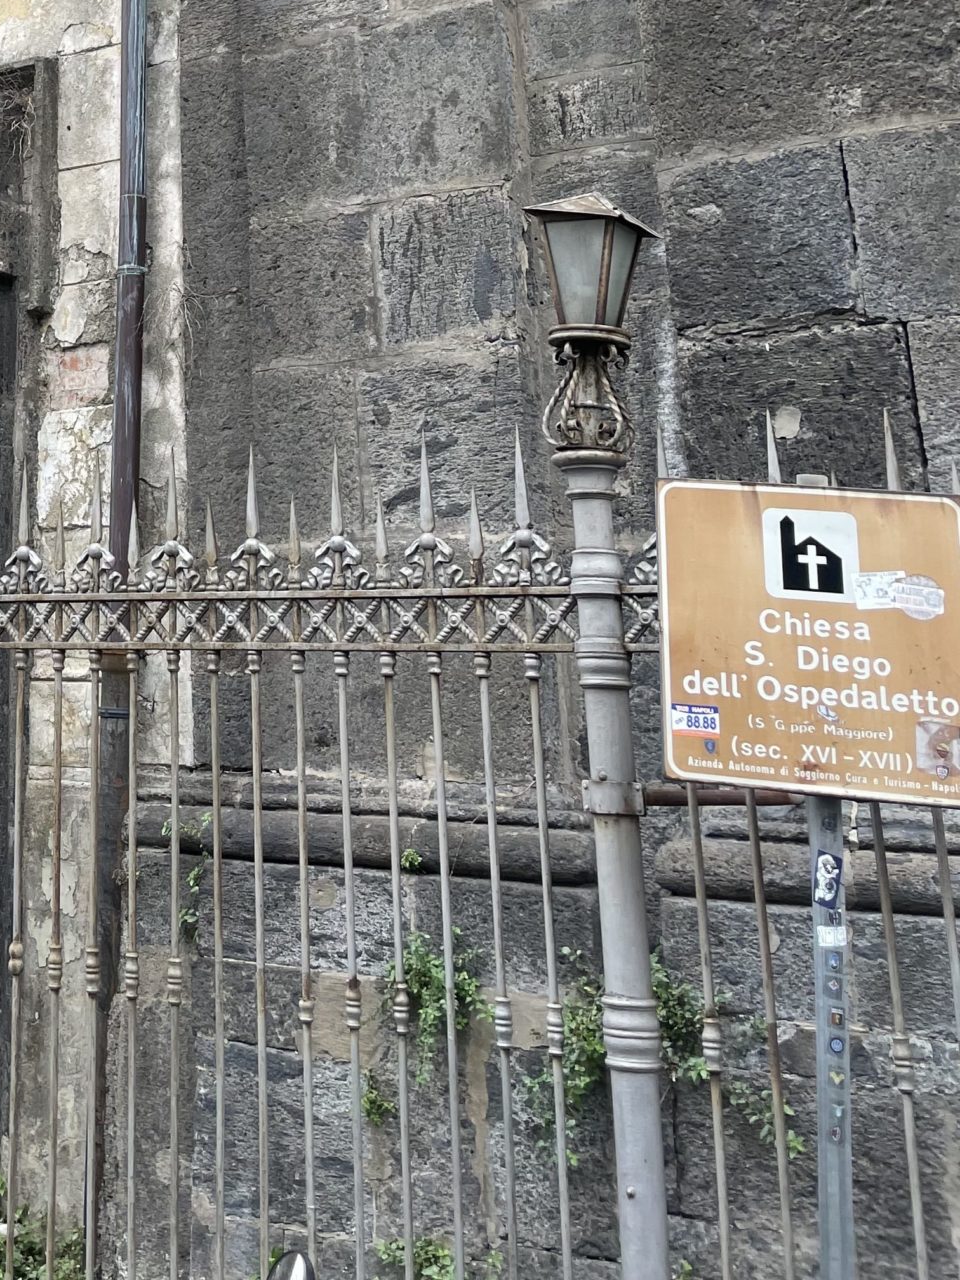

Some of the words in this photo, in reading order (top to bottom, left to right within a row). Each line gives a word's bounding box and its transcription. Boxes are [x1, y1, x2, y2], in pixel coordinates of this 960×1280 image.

[759, 608, 871, 642] Chiesa
[744, 640, 774, 667] S.
[797, 645, 891, 680] Diego
[683, 670, 748, 698] dell'
[756, 675, 960, 717] Ospedaletto
[823, 724, 893, 741] Maggiore)
[731, 735, 788, 760] (sec.
[801, 744, 837, 765] XVI
[688, 756, 723, 769] Azienda
[728, 760, 775, 775] Autonoma
[780, 765, 789, 776] di
[794, 767, 840, 781] Soggiorno
[845, 772, 868, 784] Cura
[884, 776, 921, 789] Turismo
